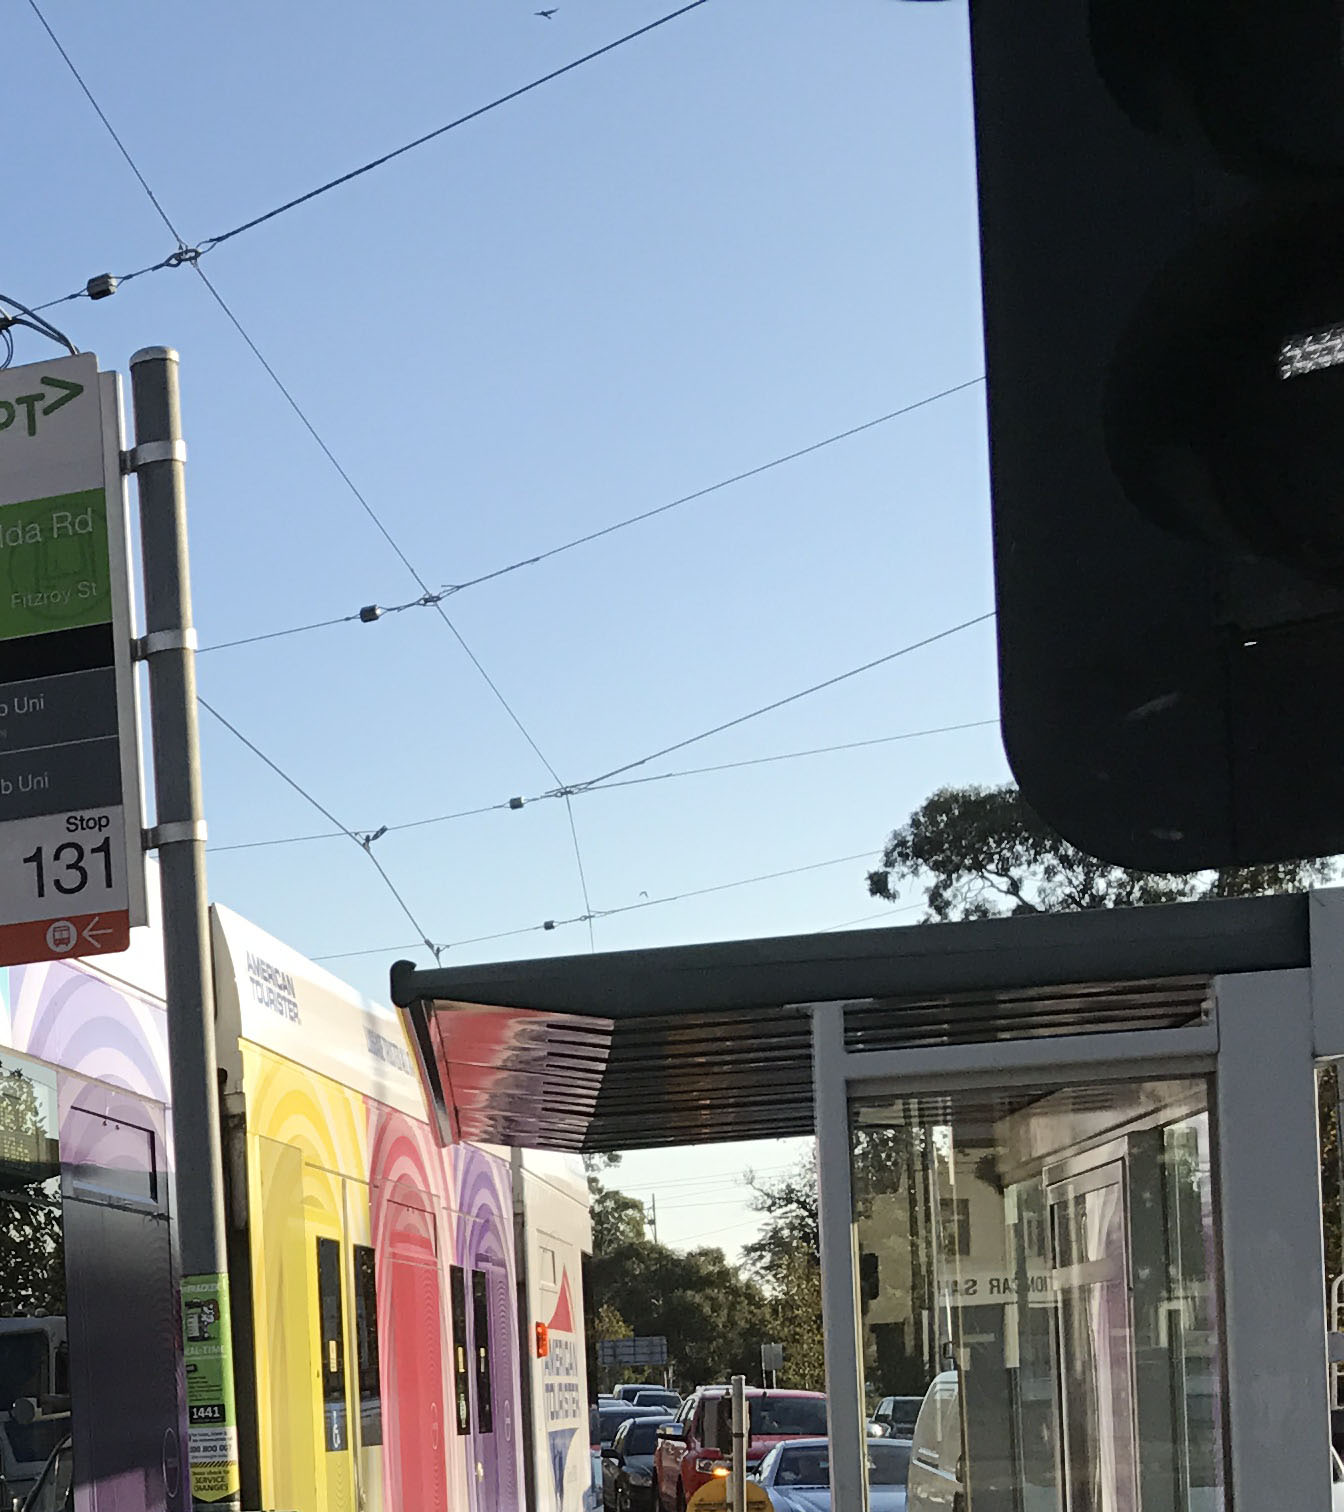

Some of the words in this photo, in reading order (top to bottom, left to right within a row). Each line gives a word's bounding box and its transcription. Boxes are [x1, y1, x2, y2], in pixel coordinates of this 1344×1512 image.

[52, 507, 94, 538] Rd
[11, 585, 72, 609] Fitzroy
[77, 581, 97, 599] St
[14, 694, 45, 714] Uni
[18, 772, 49, 793] Uni
[65, 815, 110, 833] Stop
[22, 836, 114, 898] 131
[246, 950, 296, 999] AMERICAN
[192, 1405, 221, 1420] 1441
